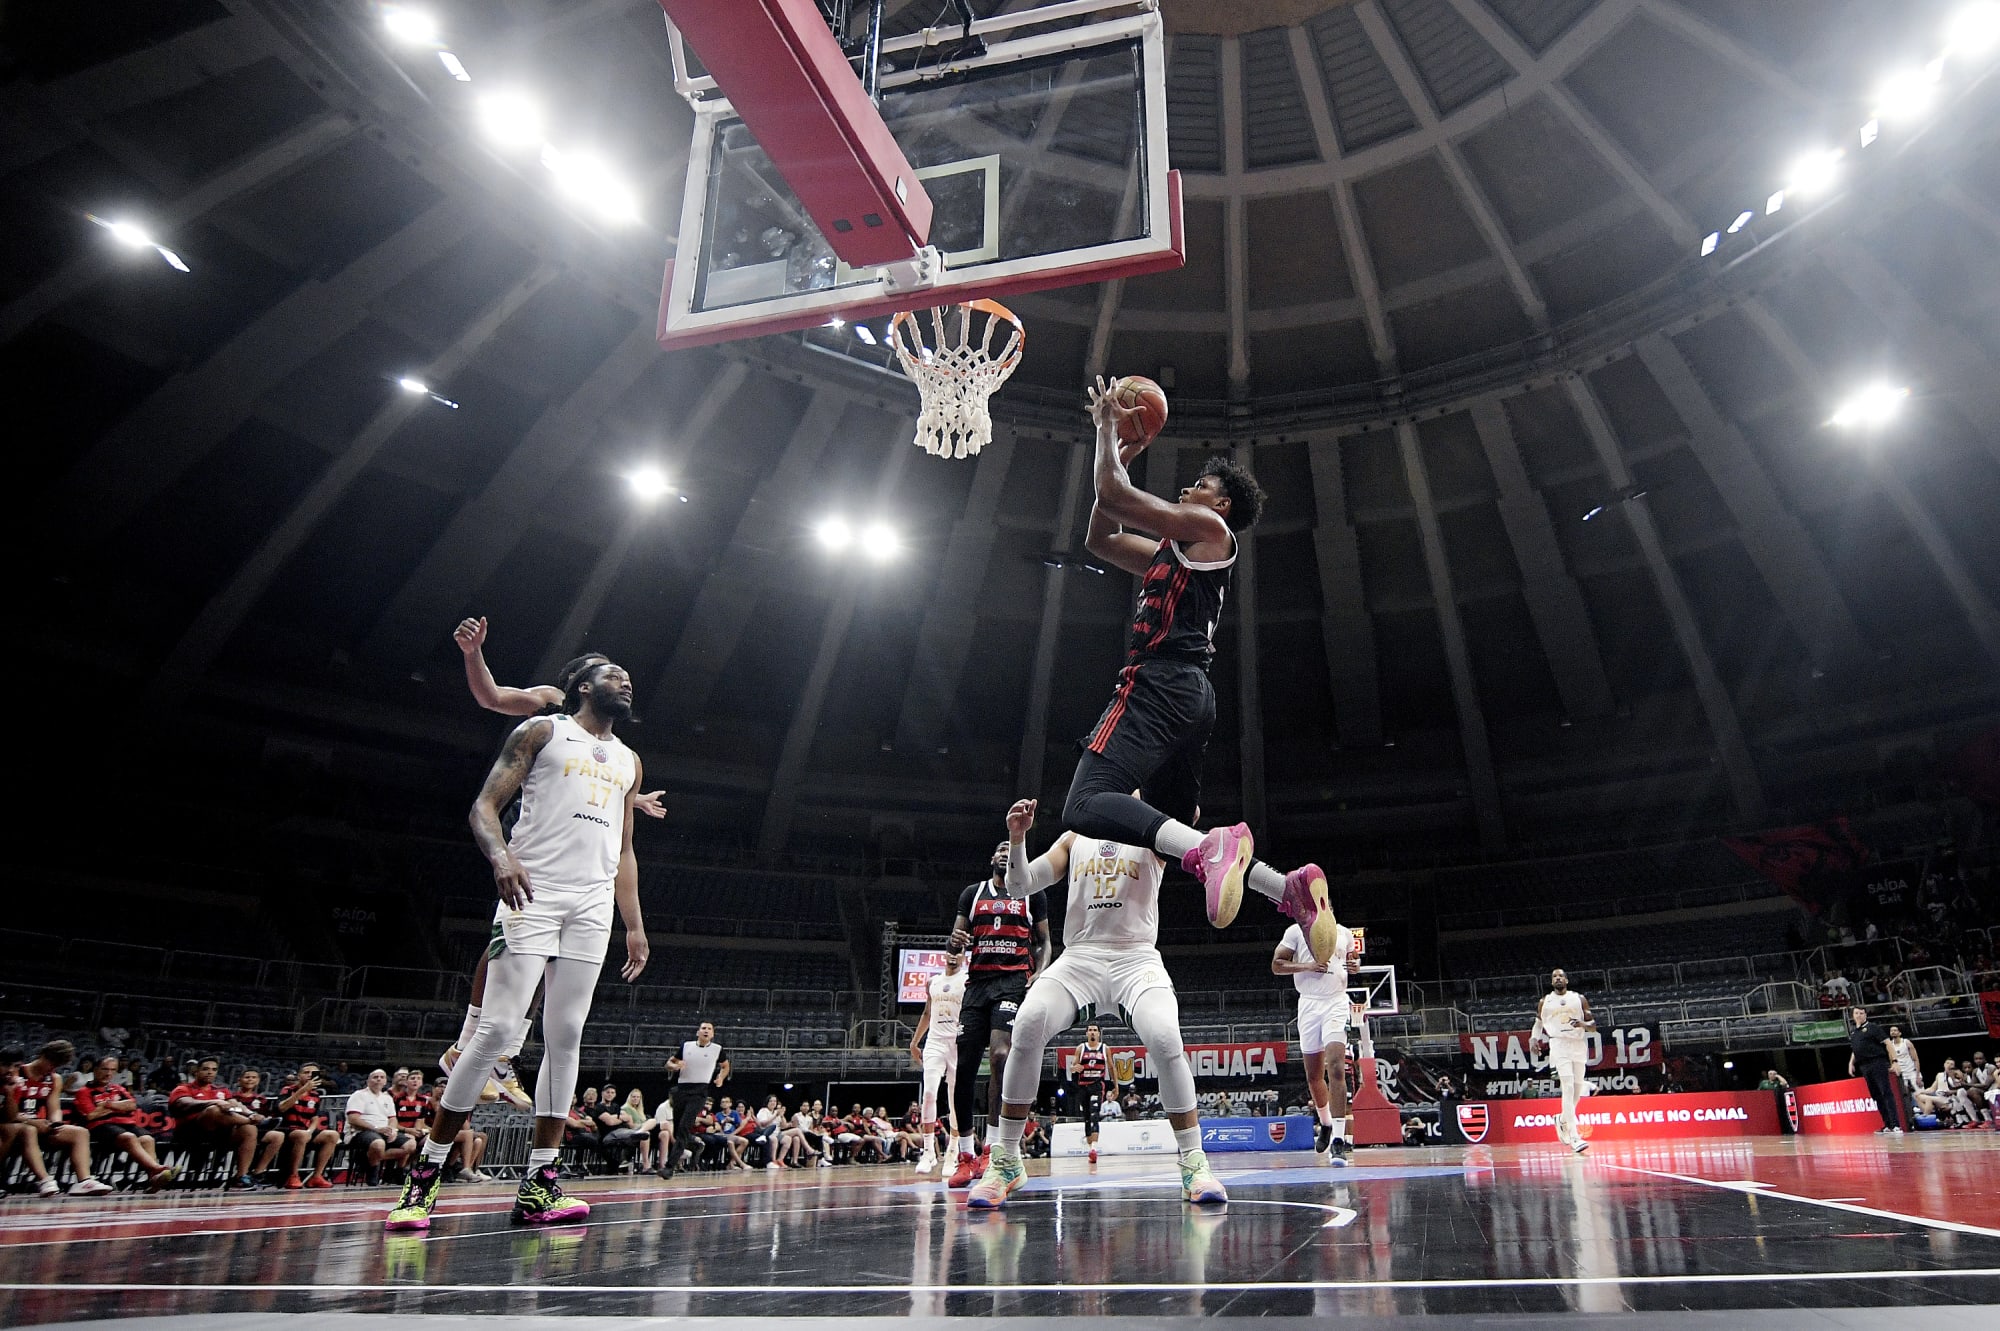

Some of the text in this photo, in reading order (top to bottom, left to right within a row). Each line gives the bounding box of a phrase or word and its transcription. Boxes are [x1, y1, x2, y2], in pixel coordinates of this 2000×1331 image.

[563, 757, 630, 792] PAISA
[586, 783, 613, 810] 17
[572, 812, 610, 828] AWOO
[1093, 876, 1117, 899] 15
[1087, 901, 1123, 910] AWOO
[993, 915, 1002, 931] 8
[908, 972, 926, 987] 59
[1612, 1027, 1651, 1064] 12
[1615, 1112, 1627, 1124] A
[1629, 1110, 1665, 1124] LIVE
[1667, 1109, 1691, 1122] NO
[1693, 1107, 1748, 1122] CANAL
